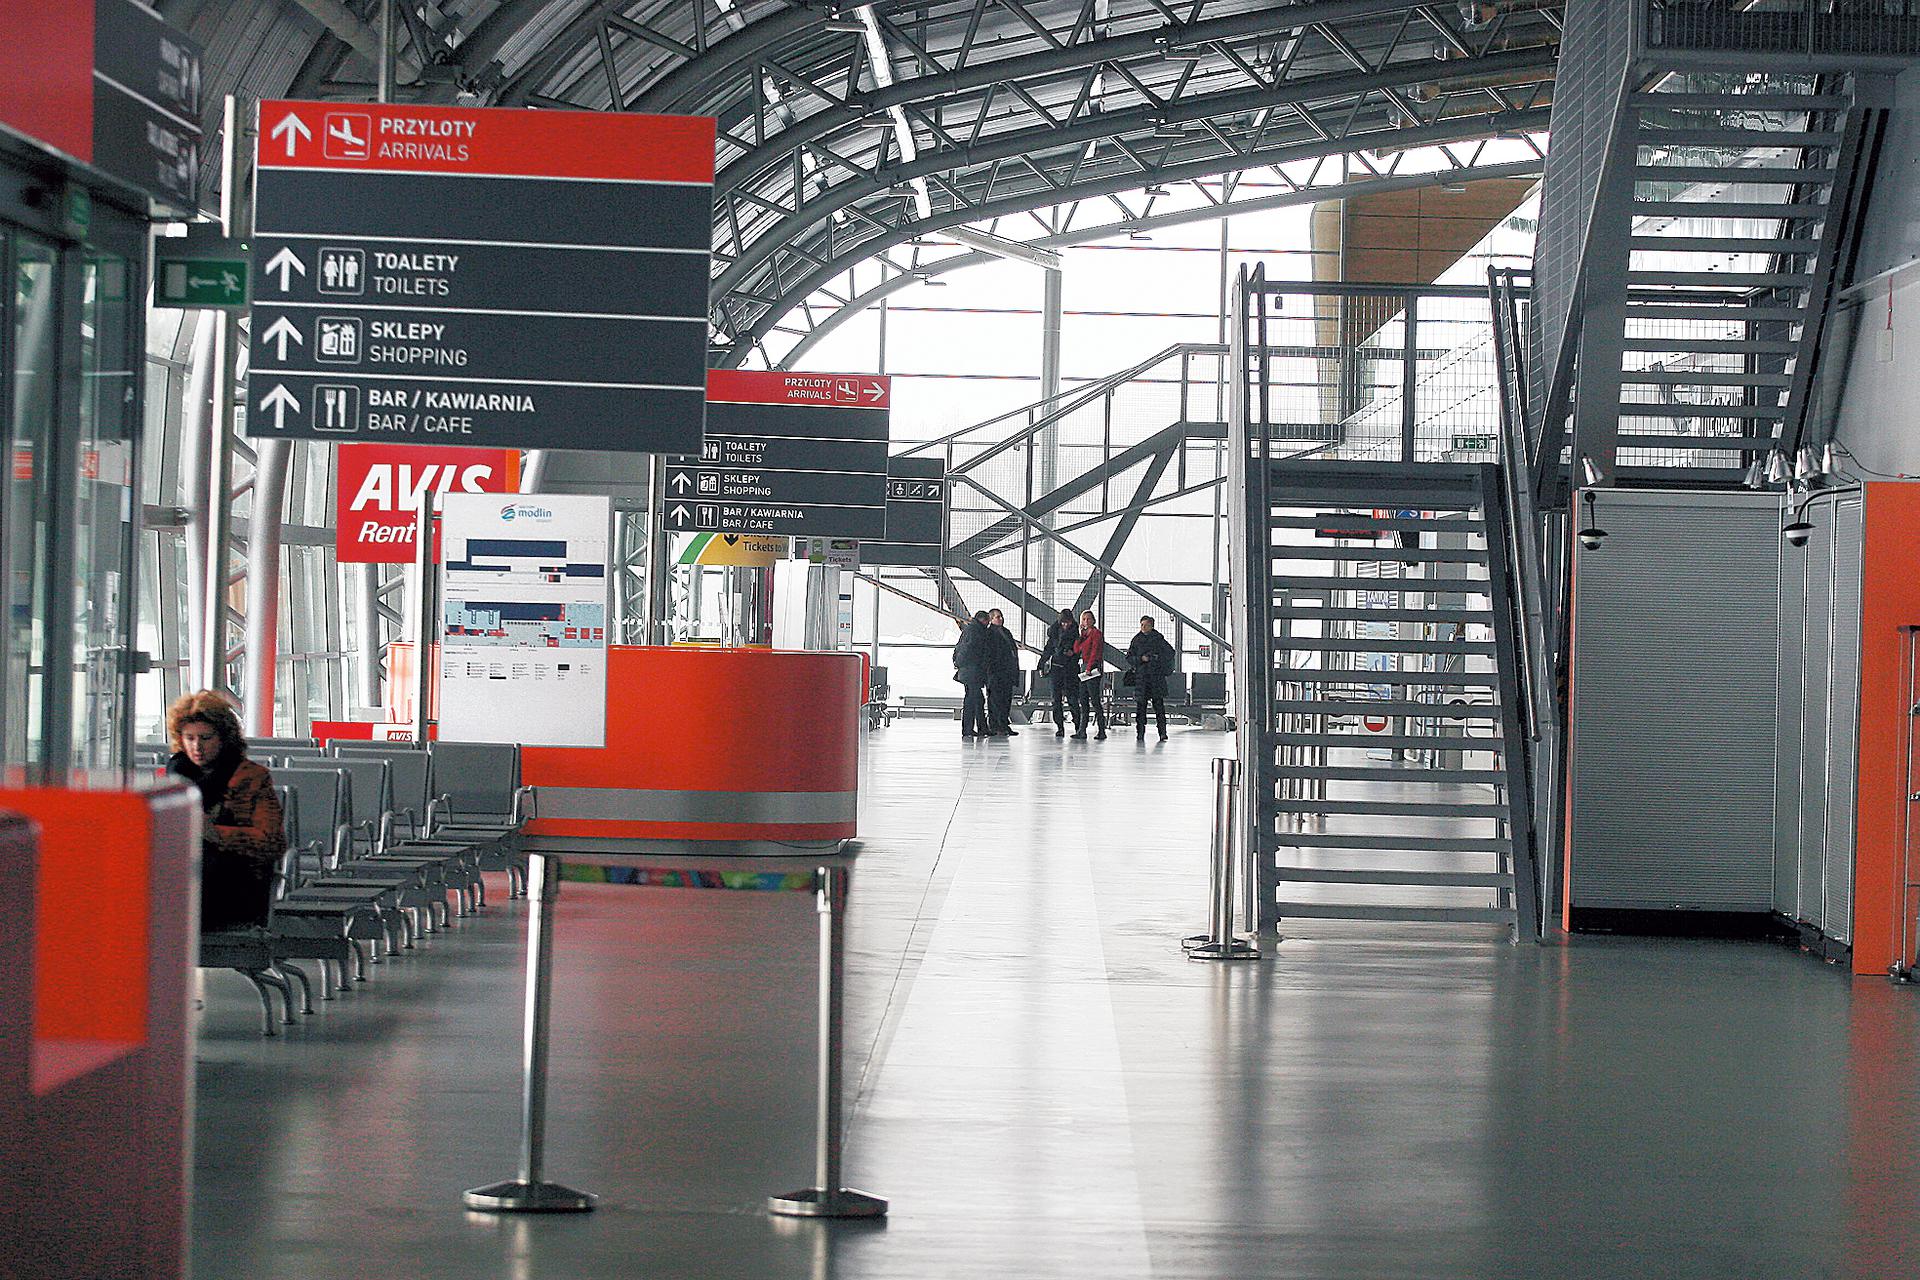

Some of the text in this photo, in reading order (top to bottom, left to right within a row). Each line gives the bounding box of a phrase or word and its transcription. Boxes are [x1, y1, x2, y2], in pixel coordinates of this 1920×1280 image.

[379, 117, 477, 138] PRZYLOTY
[378, 142, 470, 162] ARRIVALS
[374, 252, 459, 273] TOALETY
[373, 276, 450, 297] TOILETS
[370, 321, 445, 342] SKLEPY
[369, 346, 468, 367] SHOPPING
[785, 378, 832, 388] PRZYLOTY
[787, 389, 832, 400] ARRIVALS
[369, 389, 536, 413] BAR / KAWIARNIA
[368, 414, 473, 435] BAR / CAFE
[725, 441, 767, 452] TOALETY
[725, 453, 763, 463] TOILETS
[723, 474, 760, 484] SKLEPY
[723, 485, 771, 497] SHOPPING
[518, 508, 552, 518] modlin
[723, 507, 742, 517] BAR
[750, 508, 804, 520] KAWIARNIA
[722, 518, 742, 529] BAR
[750, 519, 774, 530] CAFE
[357, 521, 417, 543] Rent
[743, 541, 774, 552] Tickets
[387, 731, 412, 741] AVIS
